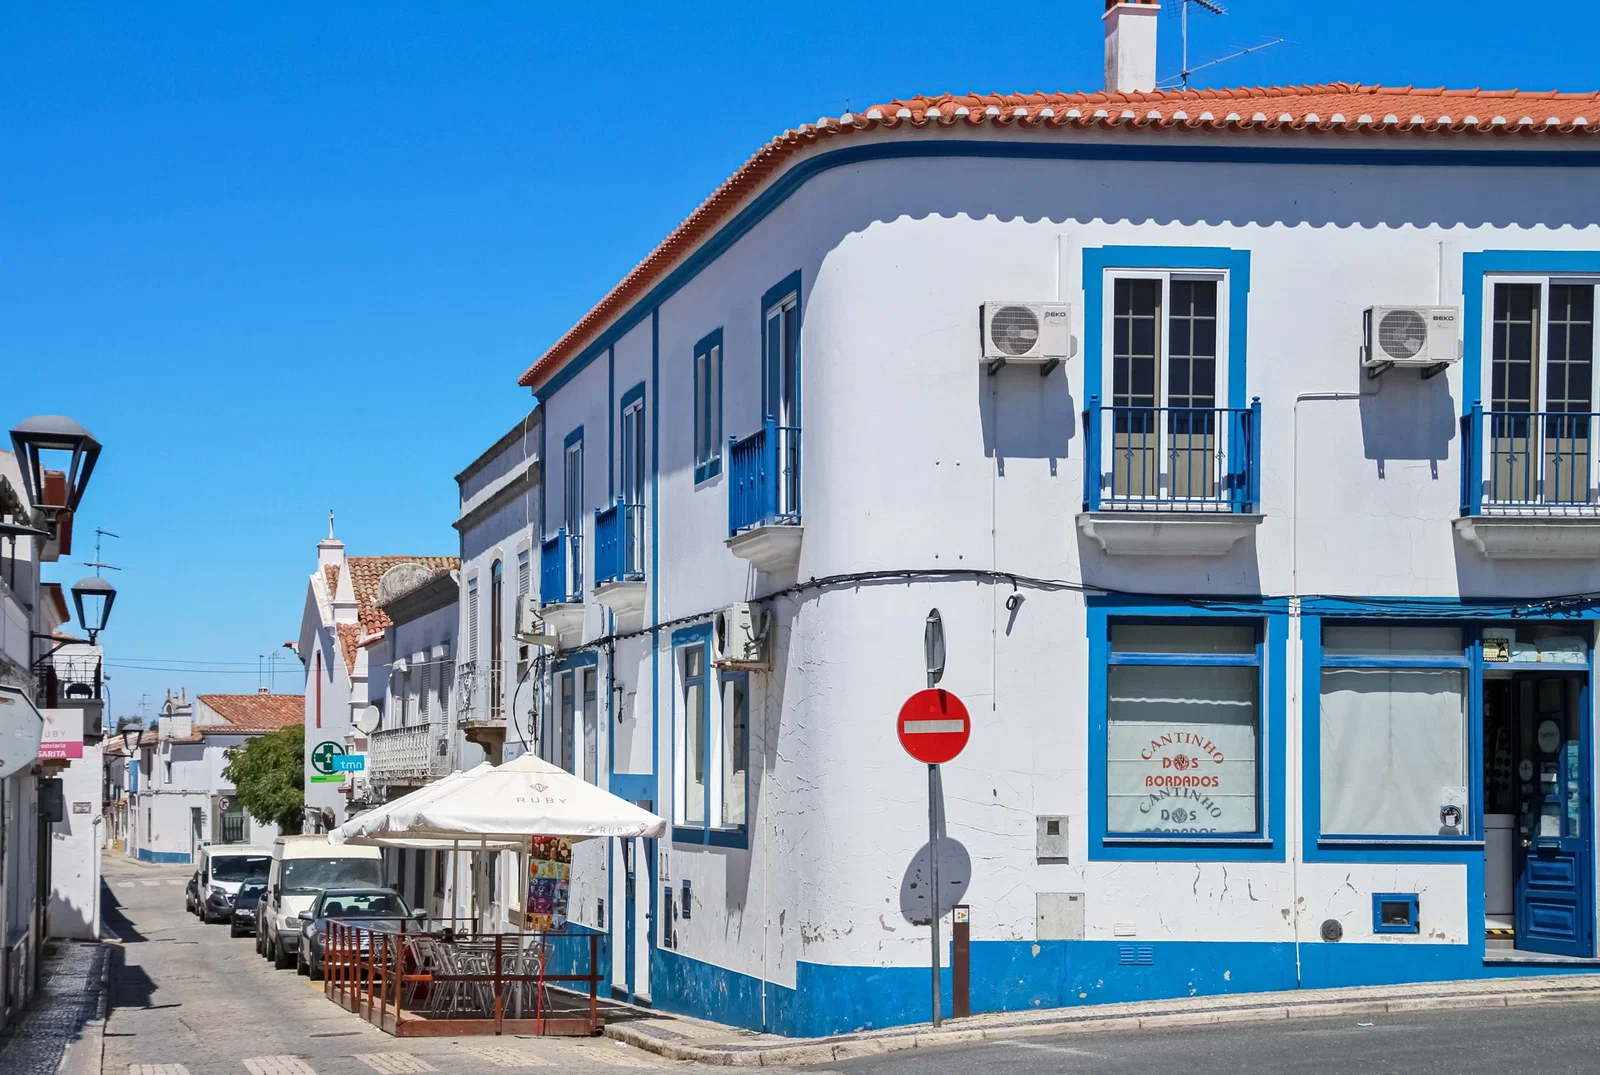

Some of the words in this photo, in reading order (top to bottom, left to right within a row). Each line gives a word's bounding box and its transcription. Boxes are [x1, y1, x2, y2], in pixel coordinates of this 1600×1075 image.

[44, 730, 66, 738] UBY
[1141, 732, 1225, 765] CANTINHO
[340, 760, 363, 769] tmn
[1145, 775, 1219, 787] BORDADOS
[516, 796, 567, 804] RUBY
[1139, 787, 1222, 818] CANTINHO
